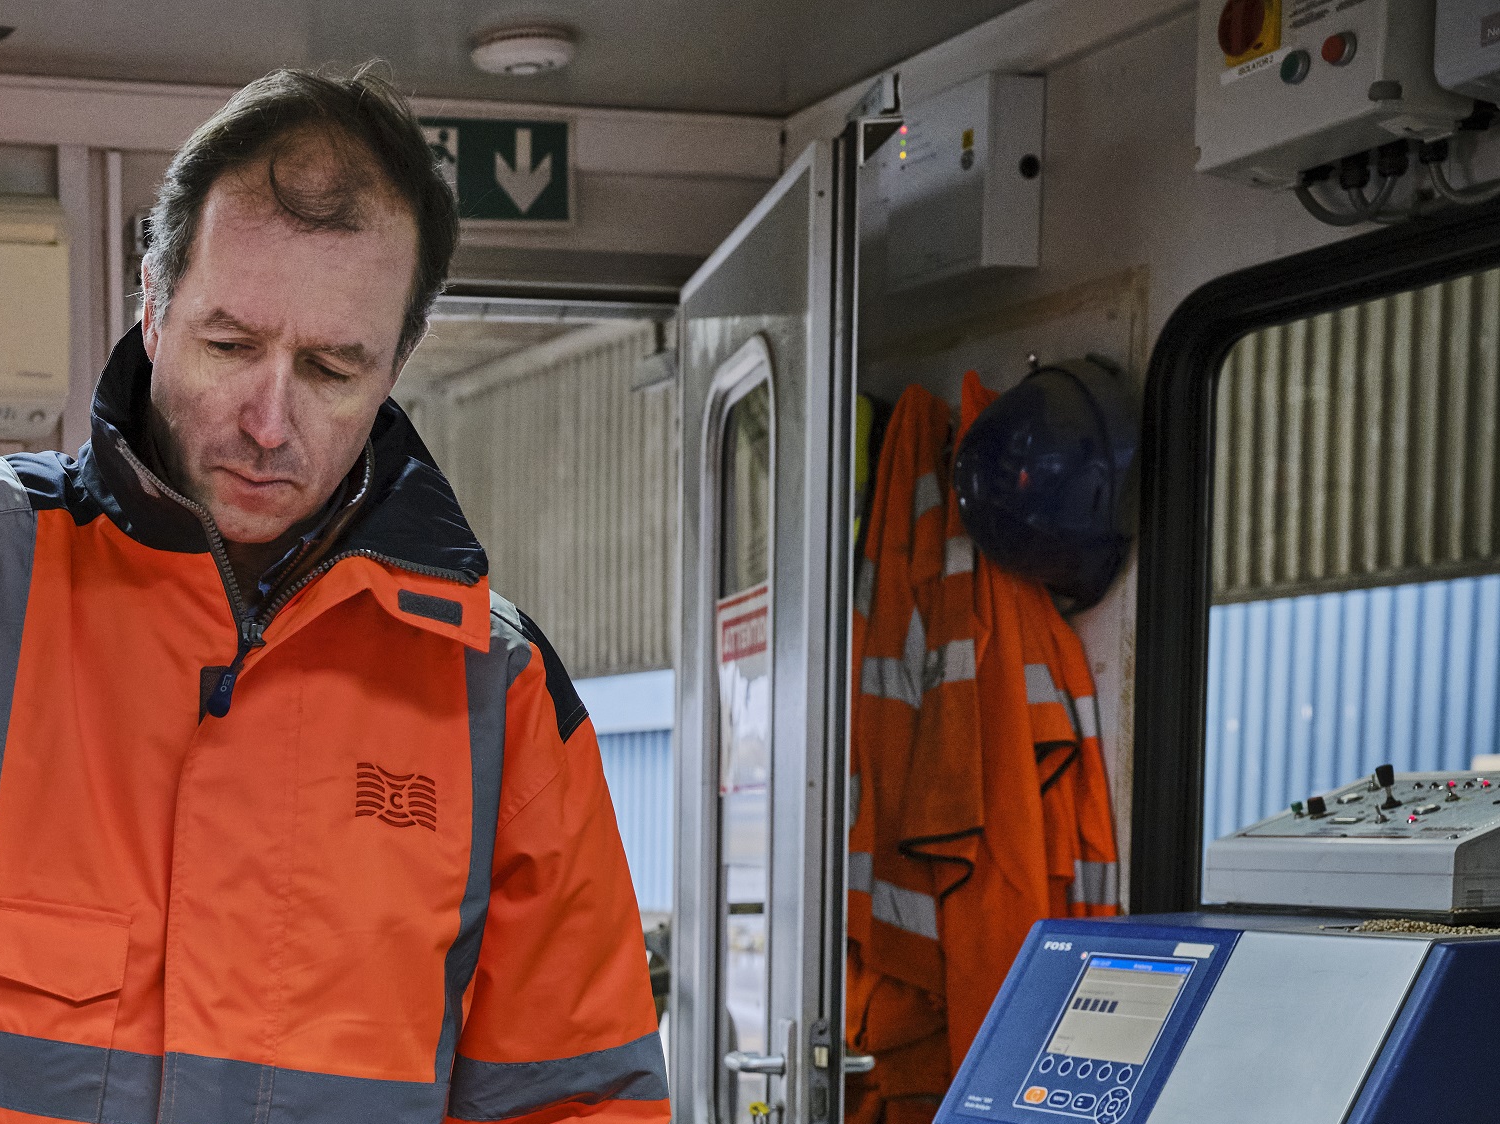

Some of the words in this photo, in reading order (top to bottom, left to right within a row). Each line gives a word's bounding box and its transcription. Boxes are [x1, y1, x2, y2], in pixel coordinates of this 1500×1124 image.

[724, 615, 767, 654] ATTENTIO
[220, 674, 232, 692] LEO
[389, 791, 404, 810] C
[1043, 940, 1073, 952] FOSS
